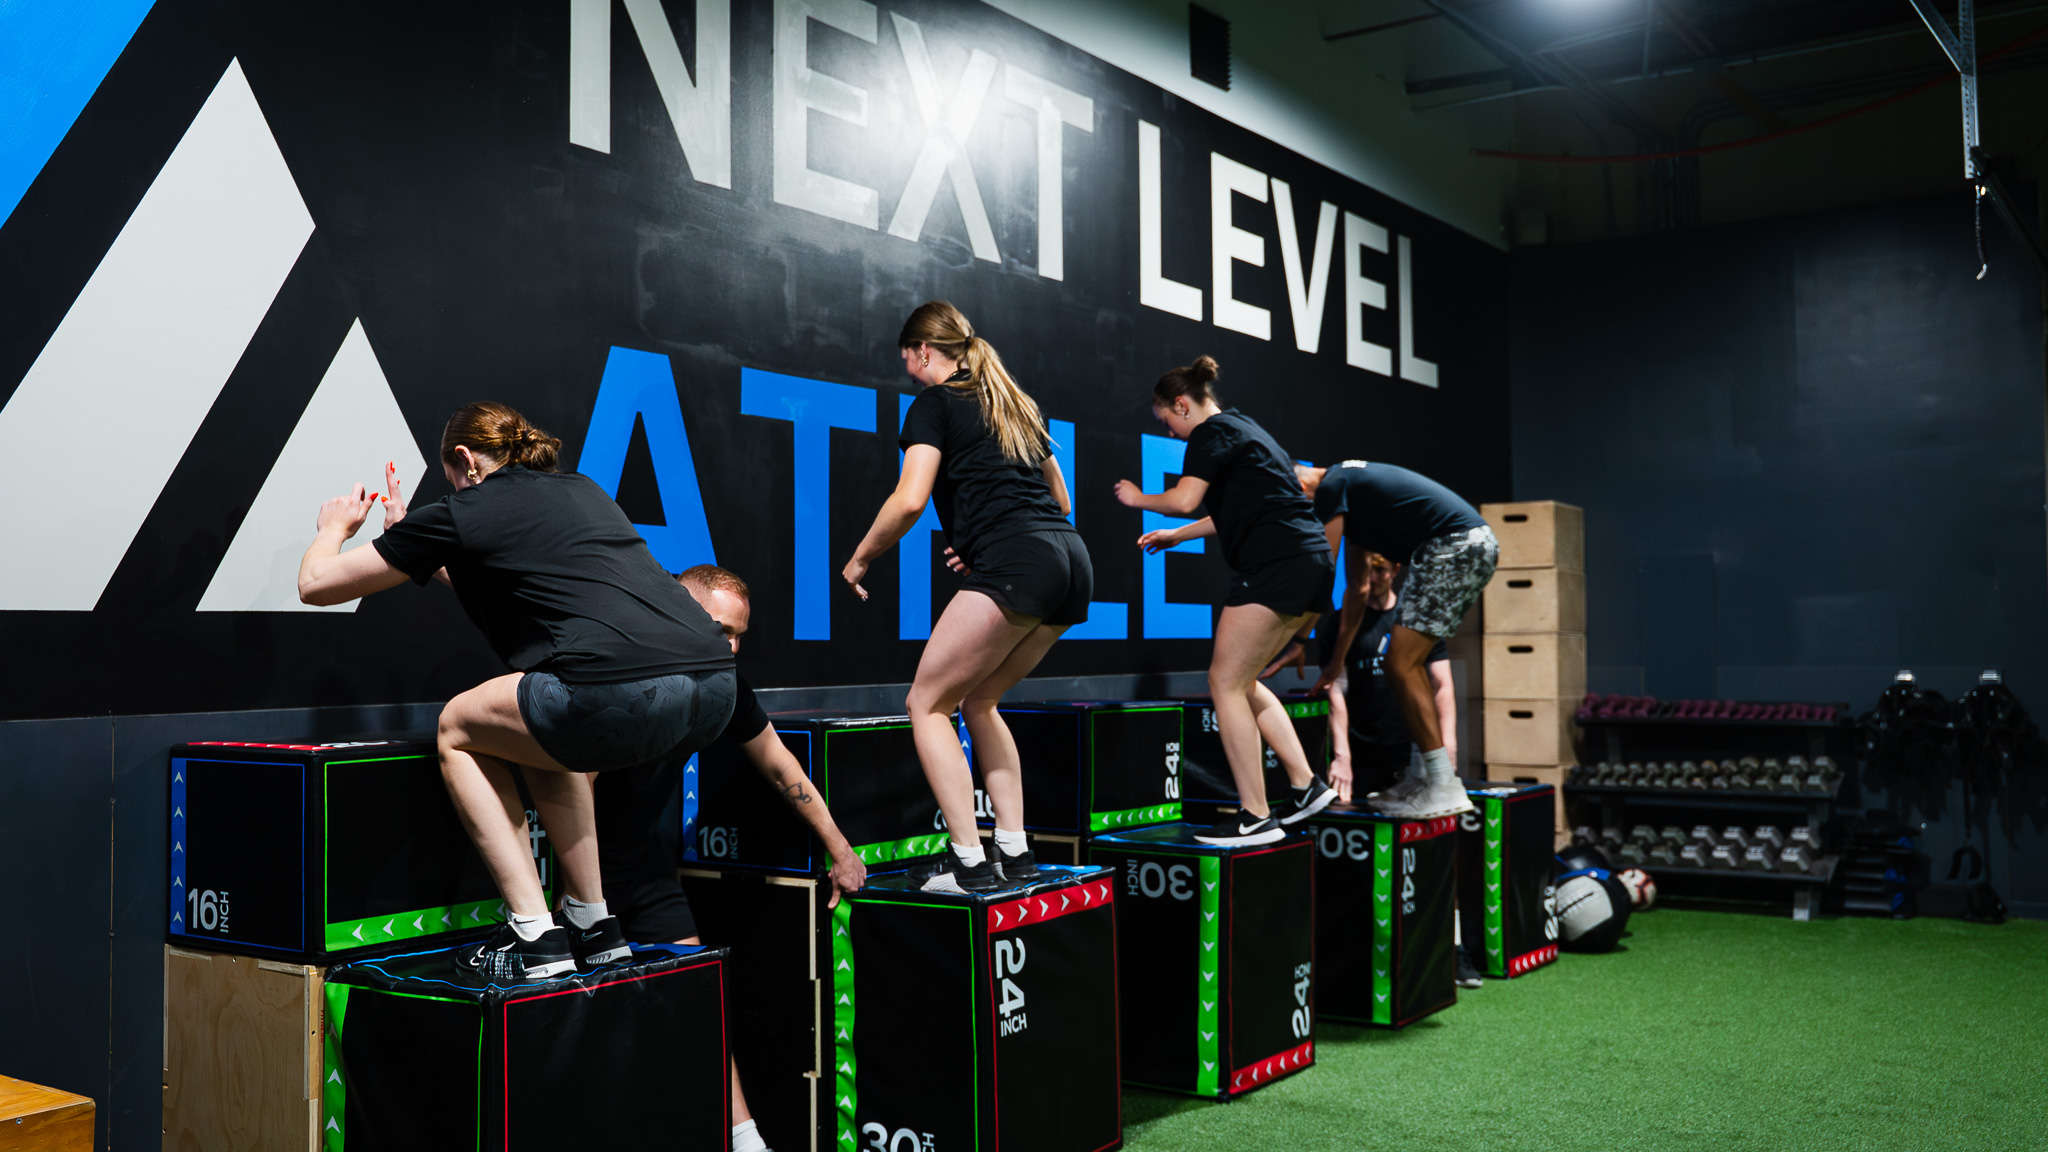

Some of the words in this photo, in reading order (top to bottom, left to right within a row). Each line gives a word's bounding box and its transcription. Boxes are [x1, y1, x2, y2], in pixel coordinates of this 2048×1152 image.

[570, 0, 1094, 281] NEXT
[1138, 119, 1439, 388] LEVEL
[1165, 752, 1180, 799] 24
[699, 826, 728, 857] 16
[729, 827, 738, 859] INCH
[1319, 827, 1369, 861] 30
[1126, 859, 1138, 896] INCH
[1139, 861, 1194, 900] 30
[1401, 848, 1416, 902] 24
[188, 888, 218, 930] 16
[220, 891, 229, 933] INCH
[995, 937, 1026, 1018] 24
[1000, 1012, 1027, 1037] INCH
[1292, 976, 1311, 1038] 24
